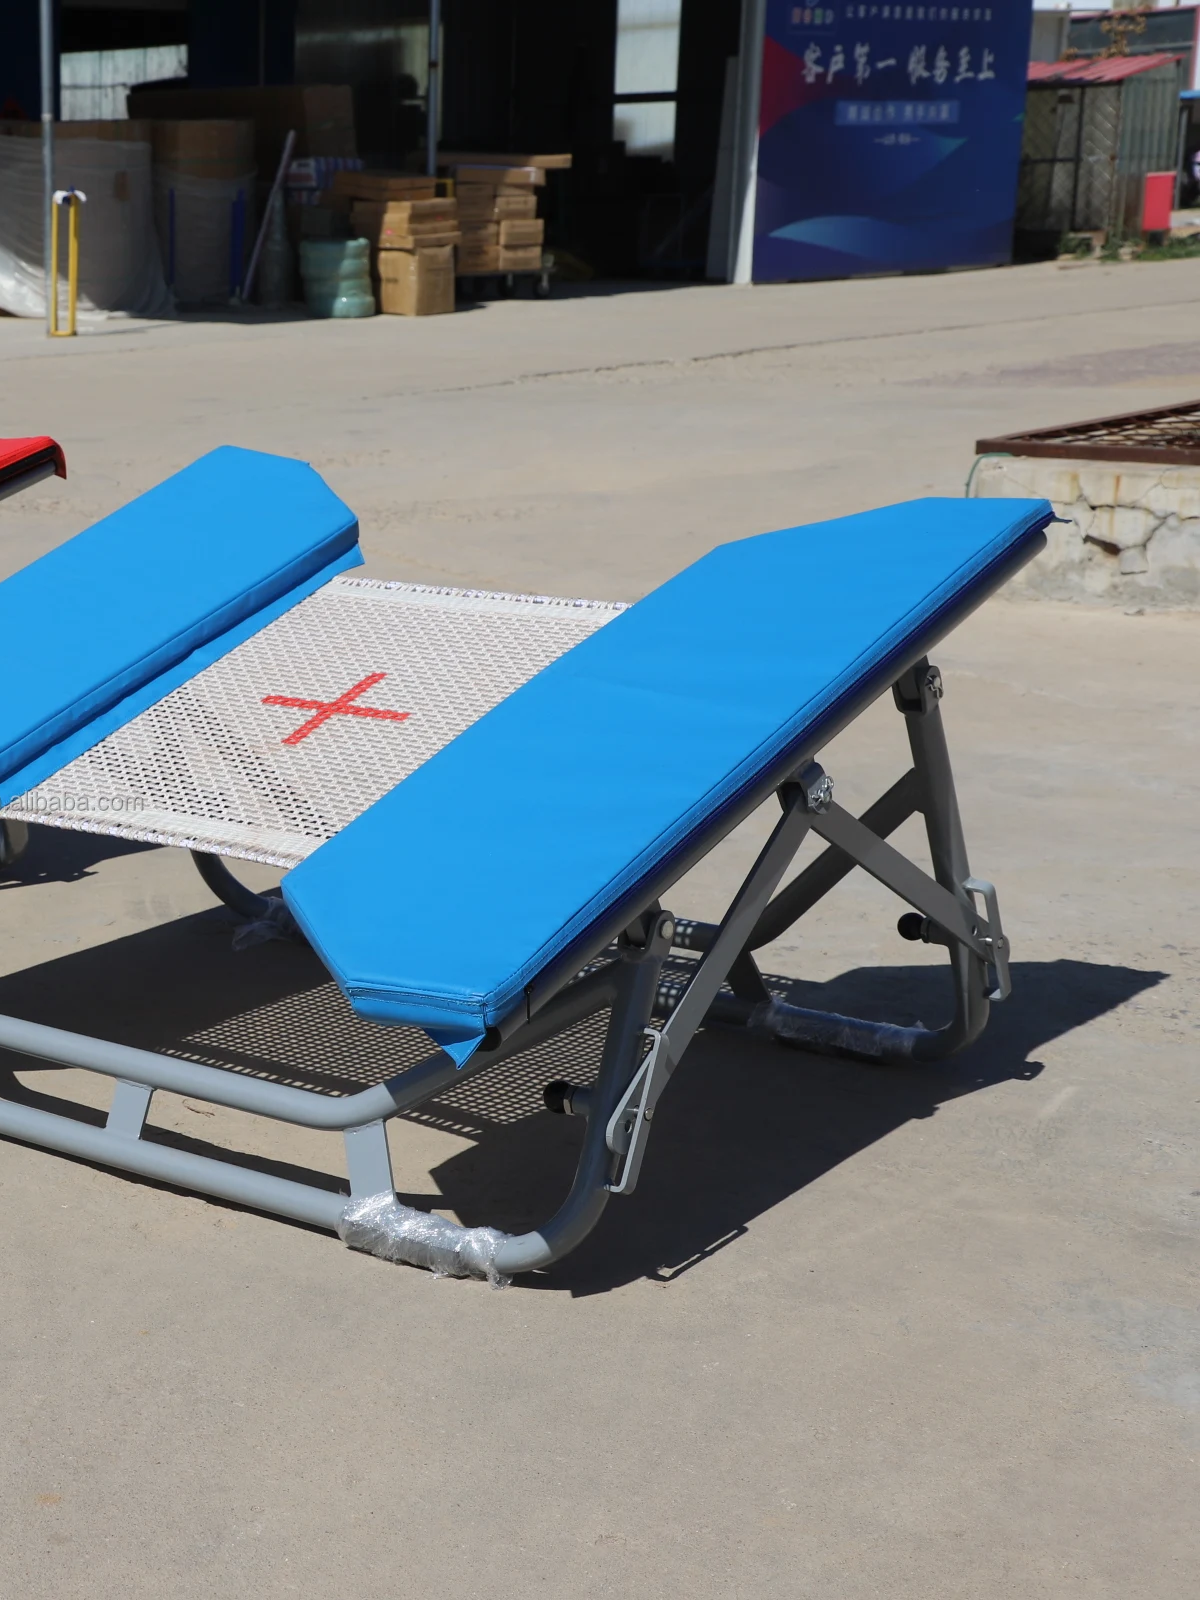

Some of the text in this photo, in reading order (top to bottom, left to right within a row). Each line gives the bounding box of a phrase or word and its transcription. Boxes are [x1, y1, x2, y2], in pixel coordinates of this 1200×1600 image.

[802, 42, 995, 85] 客户第一 服务至上
